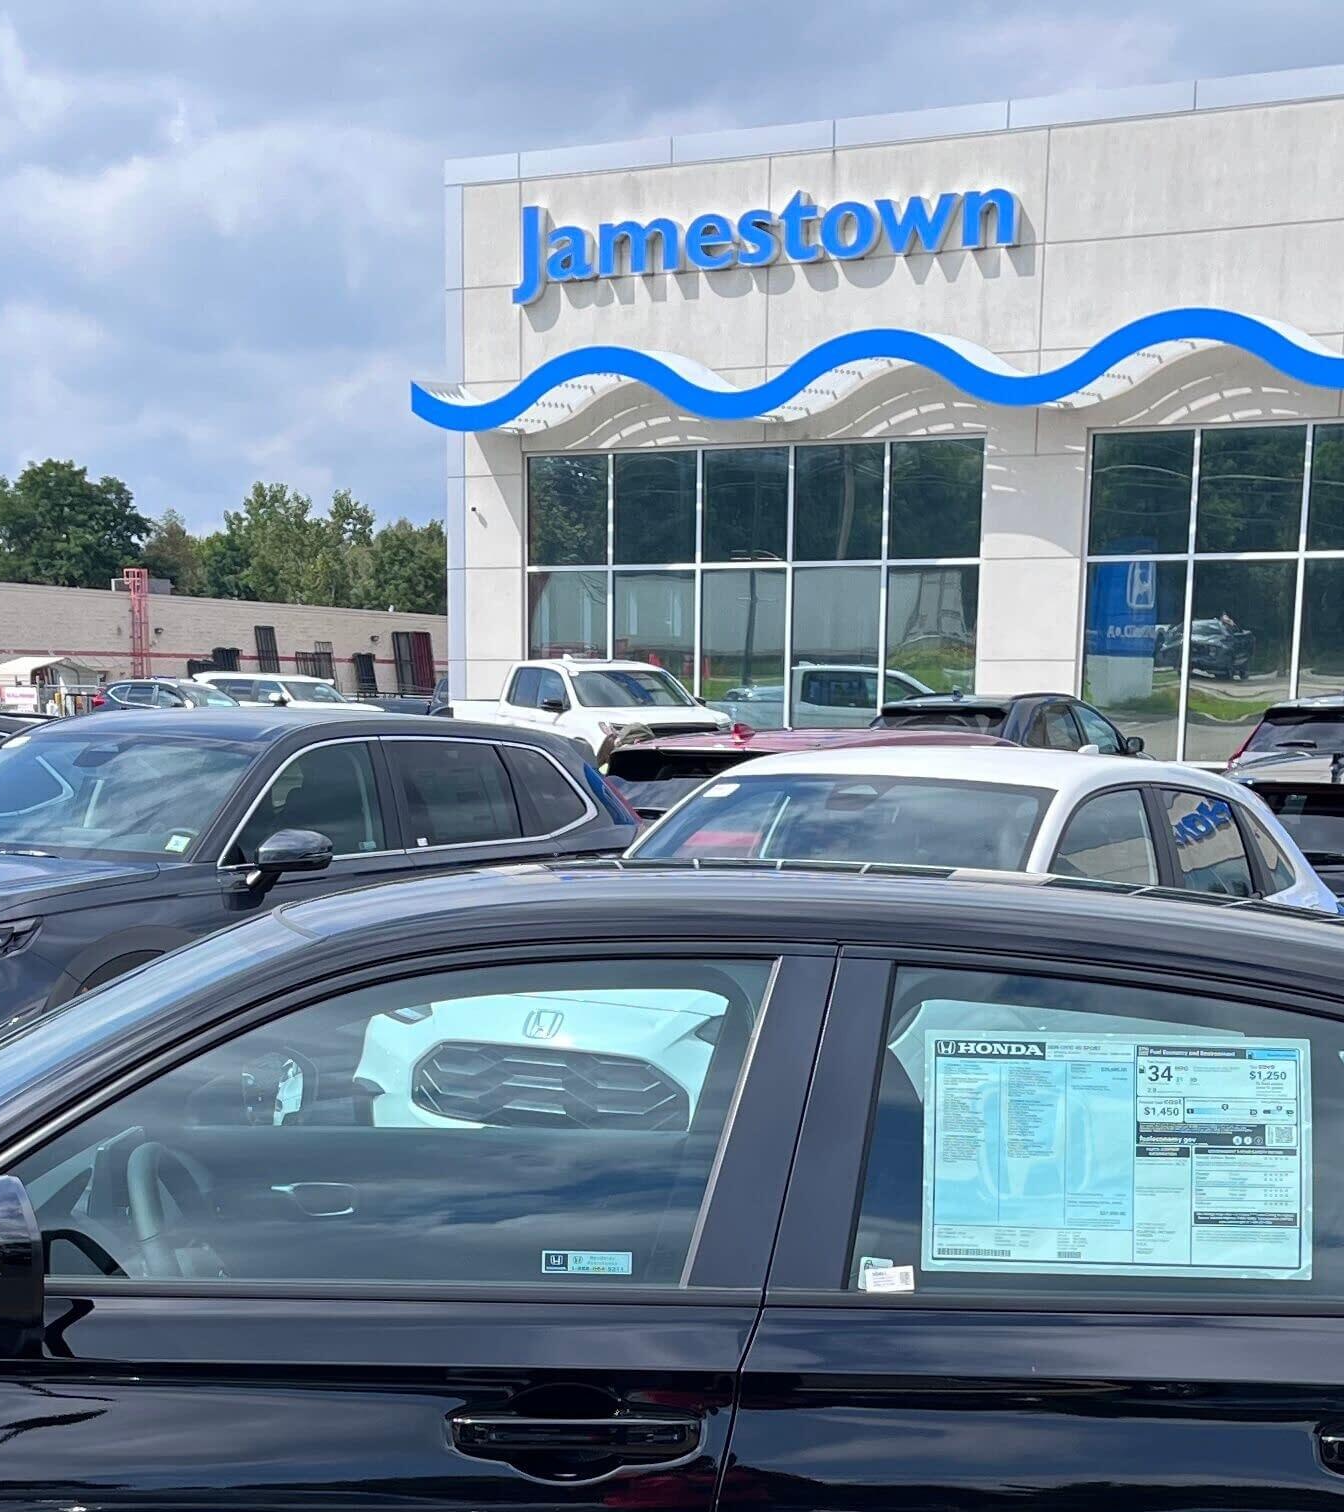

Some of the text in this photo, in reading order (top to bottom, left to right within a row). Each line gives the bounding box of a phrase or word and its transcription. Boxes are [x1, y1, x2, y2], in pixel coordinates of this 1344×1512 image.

[512, 188, 1018, 305] Jamestown
[957, 1042, 1044, 1056] HONDA
[1163, 1049, 1188, 1057] Economy
[1147, 1065, 1173, 1082] 34
[1249, 1070, 1287, 1082] $1,250
[1143, 1106, 1180, 1117] $1,450
